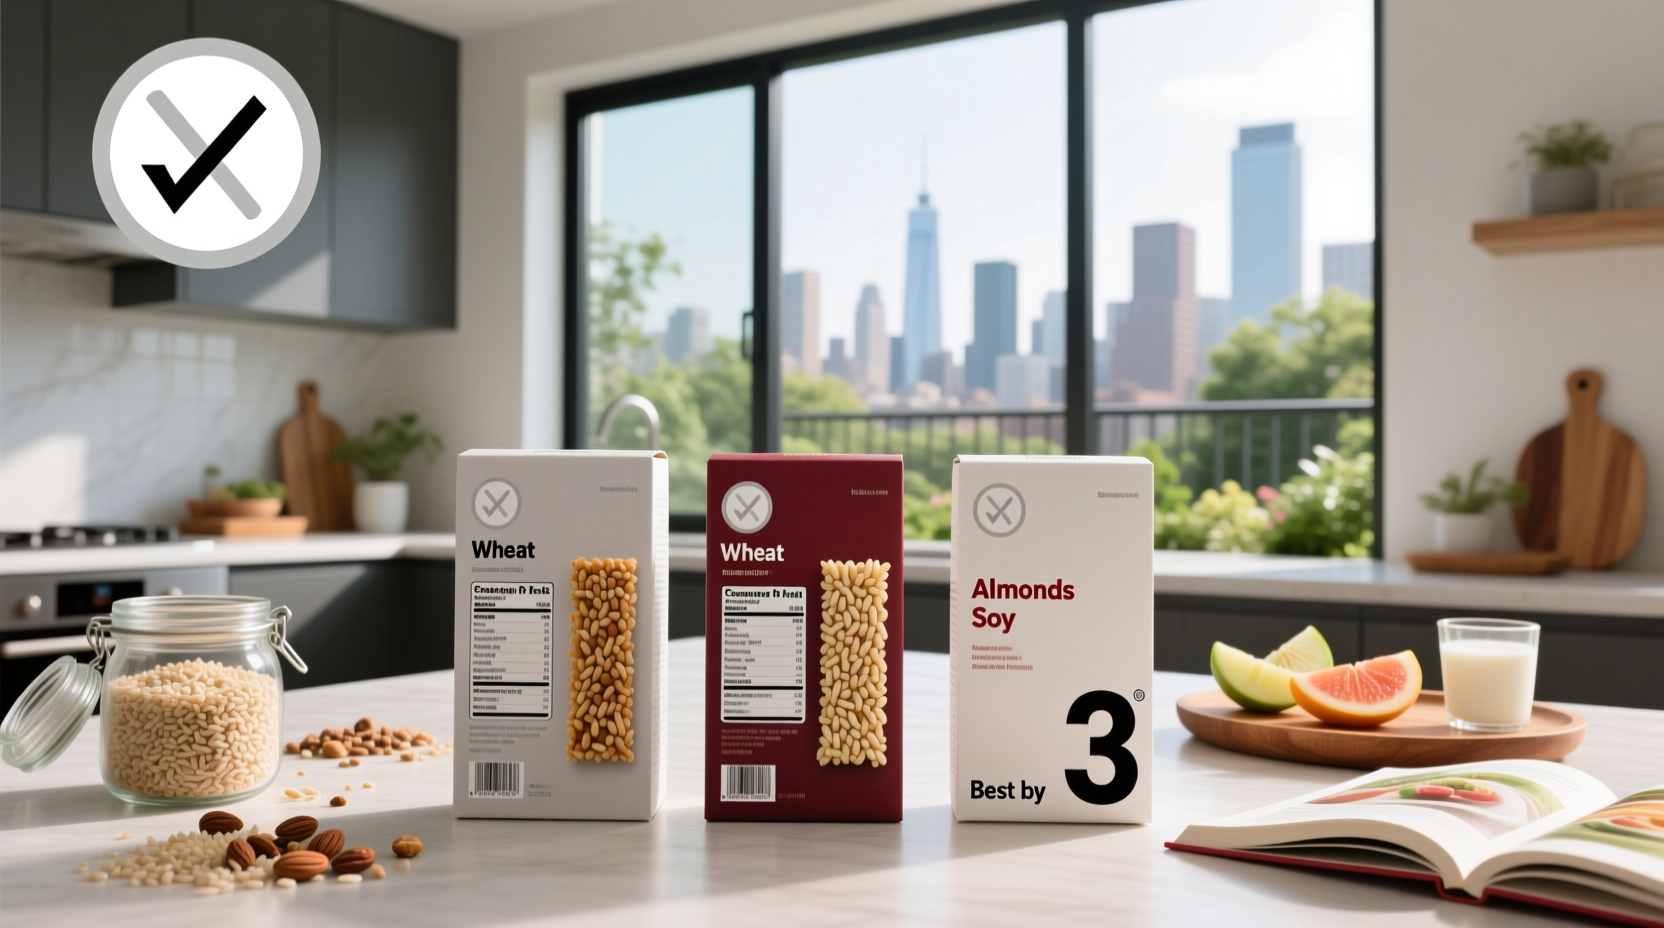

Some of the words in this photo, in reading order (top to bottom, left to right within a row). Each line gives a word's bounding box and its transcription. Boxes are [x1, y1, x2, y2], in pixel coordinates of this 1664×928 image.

[471, 540, 535, 559] Wheat
[720, 542, 785, 562] Wheat
[971, 578, 1075, 600] Almonds
[972, 606, 1016, 634] Soy
[970, 780, 1015, 800] Best
[1021, 780, 1046, 805] by
[1064, 690, 1139, 805] 3
